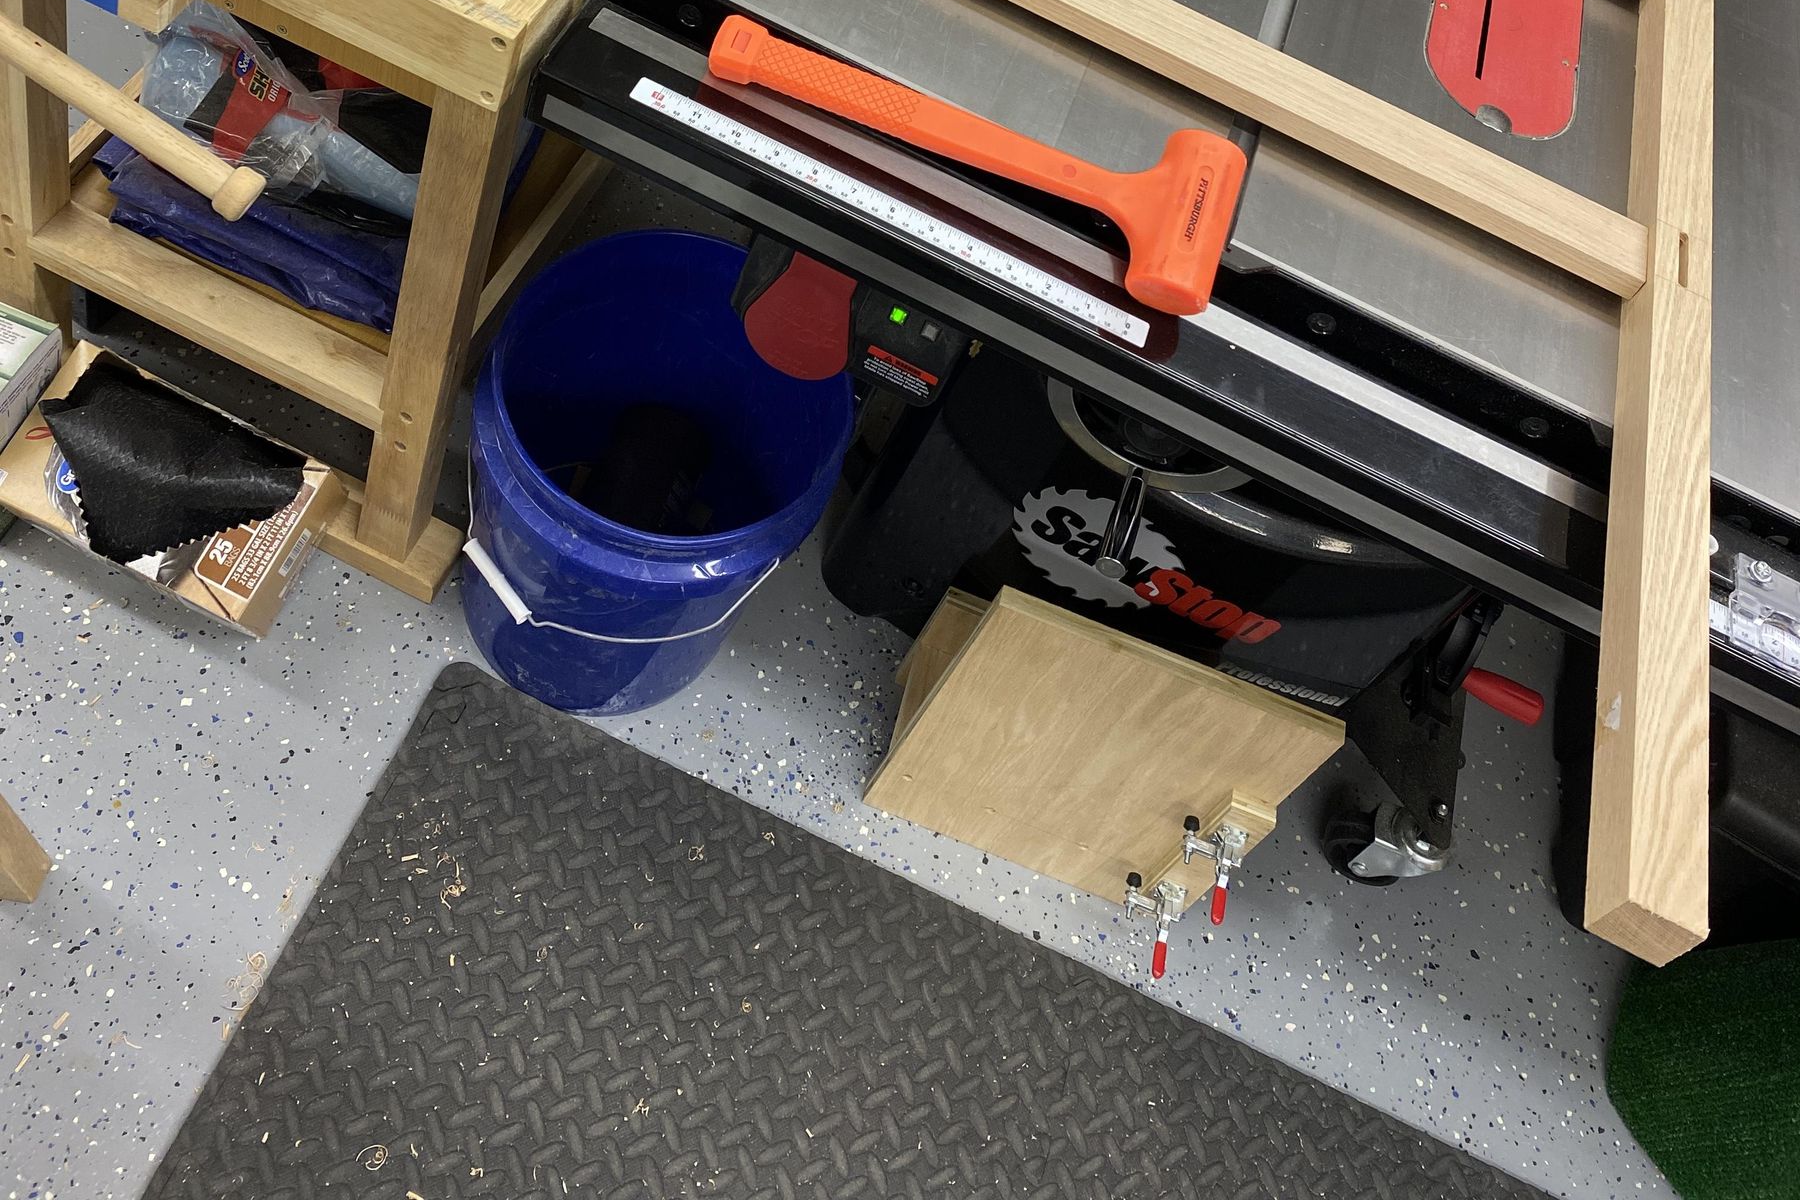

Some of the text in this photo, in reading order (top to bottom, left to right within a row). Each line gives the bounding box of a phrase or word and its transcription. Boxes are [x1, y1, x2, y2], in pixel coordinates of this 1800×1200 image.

[238, 52, 250, 72] Scot
[693, 111, 702, 119] 11
[731, 130, 741, 138] 10
[1184, 178, 1209, 242] PITTSBURGH
[207, 535, 235, 566] 25
[223, 545, 241, 568] BAGS
[231, 523, 270, 582] 25 BAGS 33 GAL SIZE
[241, 570, 251, 580] FT
[248, 555, 260, 569] 3/4
[255, 548, 264, 558] IN
[265, 532, 275, 541] FT
[270, 525, 279, 534] 11
[275, 517, 284, 526] IN
[245, 563, 265, 589] (83.1cm
[263, 537, 281, 561] 88.9cm
[1214, 662, 1349, 707] Professional
